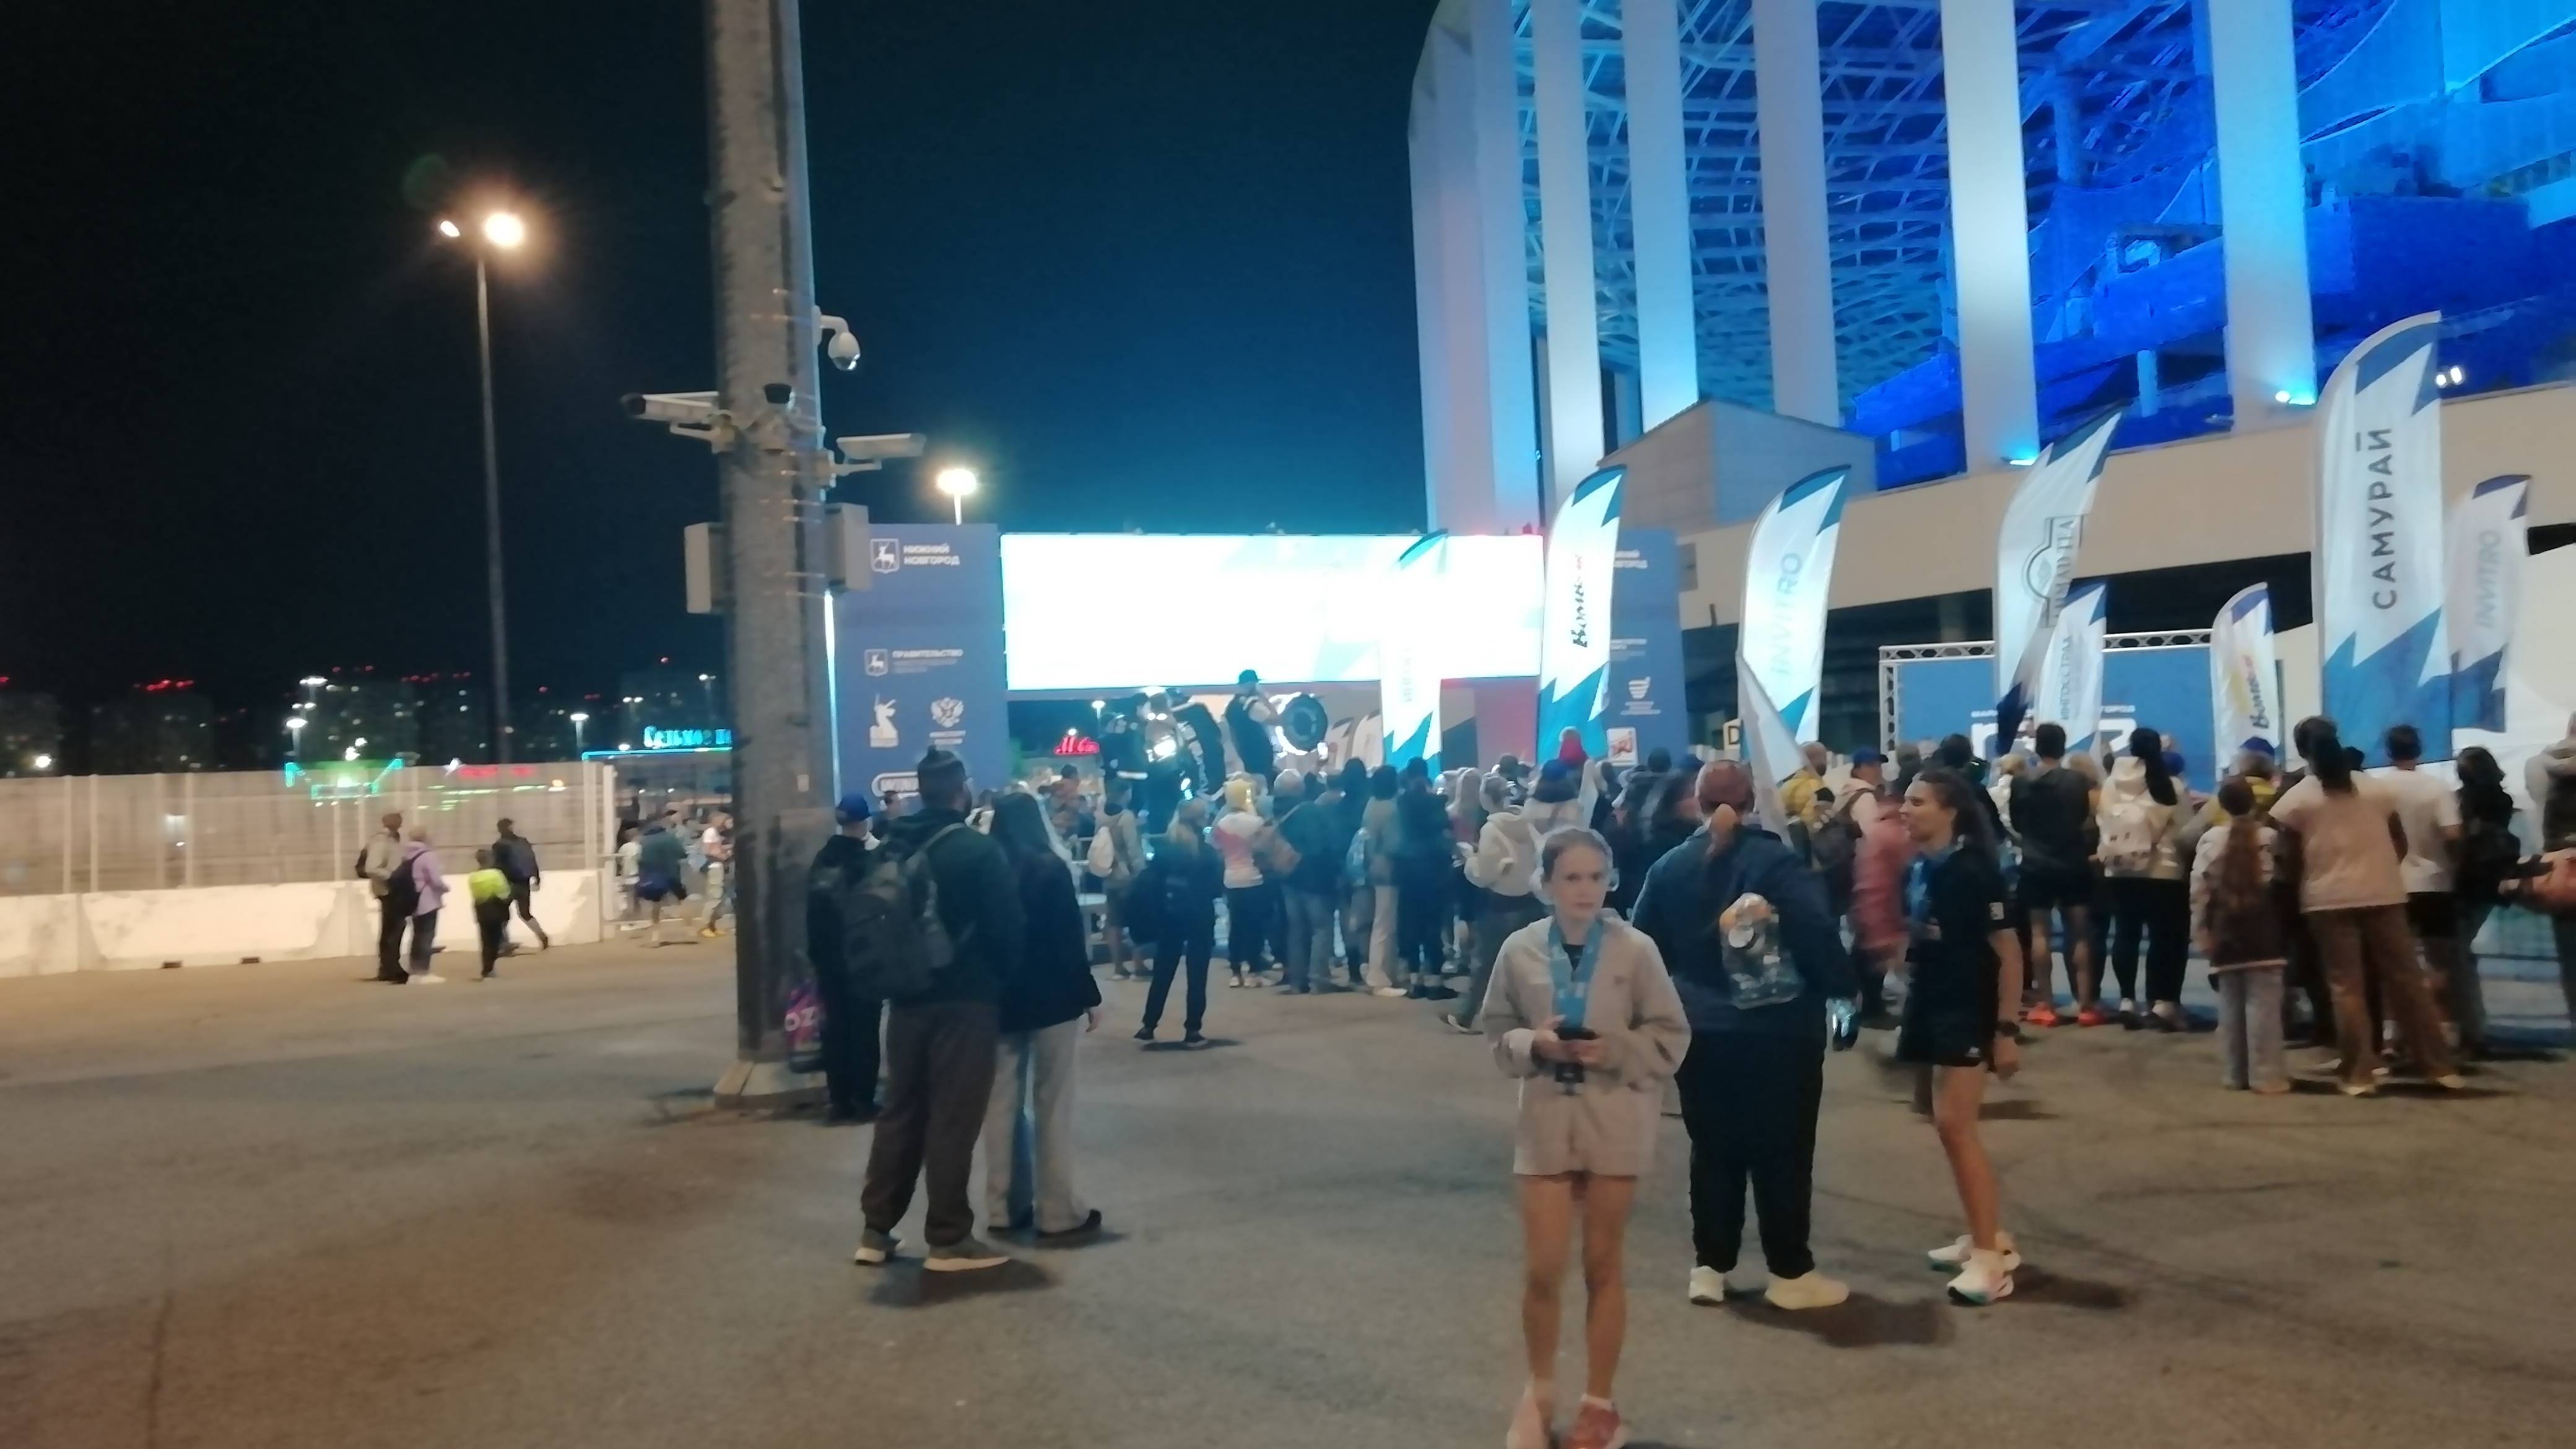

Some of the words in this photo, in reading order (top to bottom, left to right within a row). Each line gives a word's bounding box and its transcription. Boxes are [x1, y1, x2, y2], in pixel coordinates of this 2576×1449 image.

[904, 555, 960, 565] НОВГОРОД
[2355, 428, 2396, 609] САМУРАЙ
[2476, 529, 2500, 629] INVITRO
